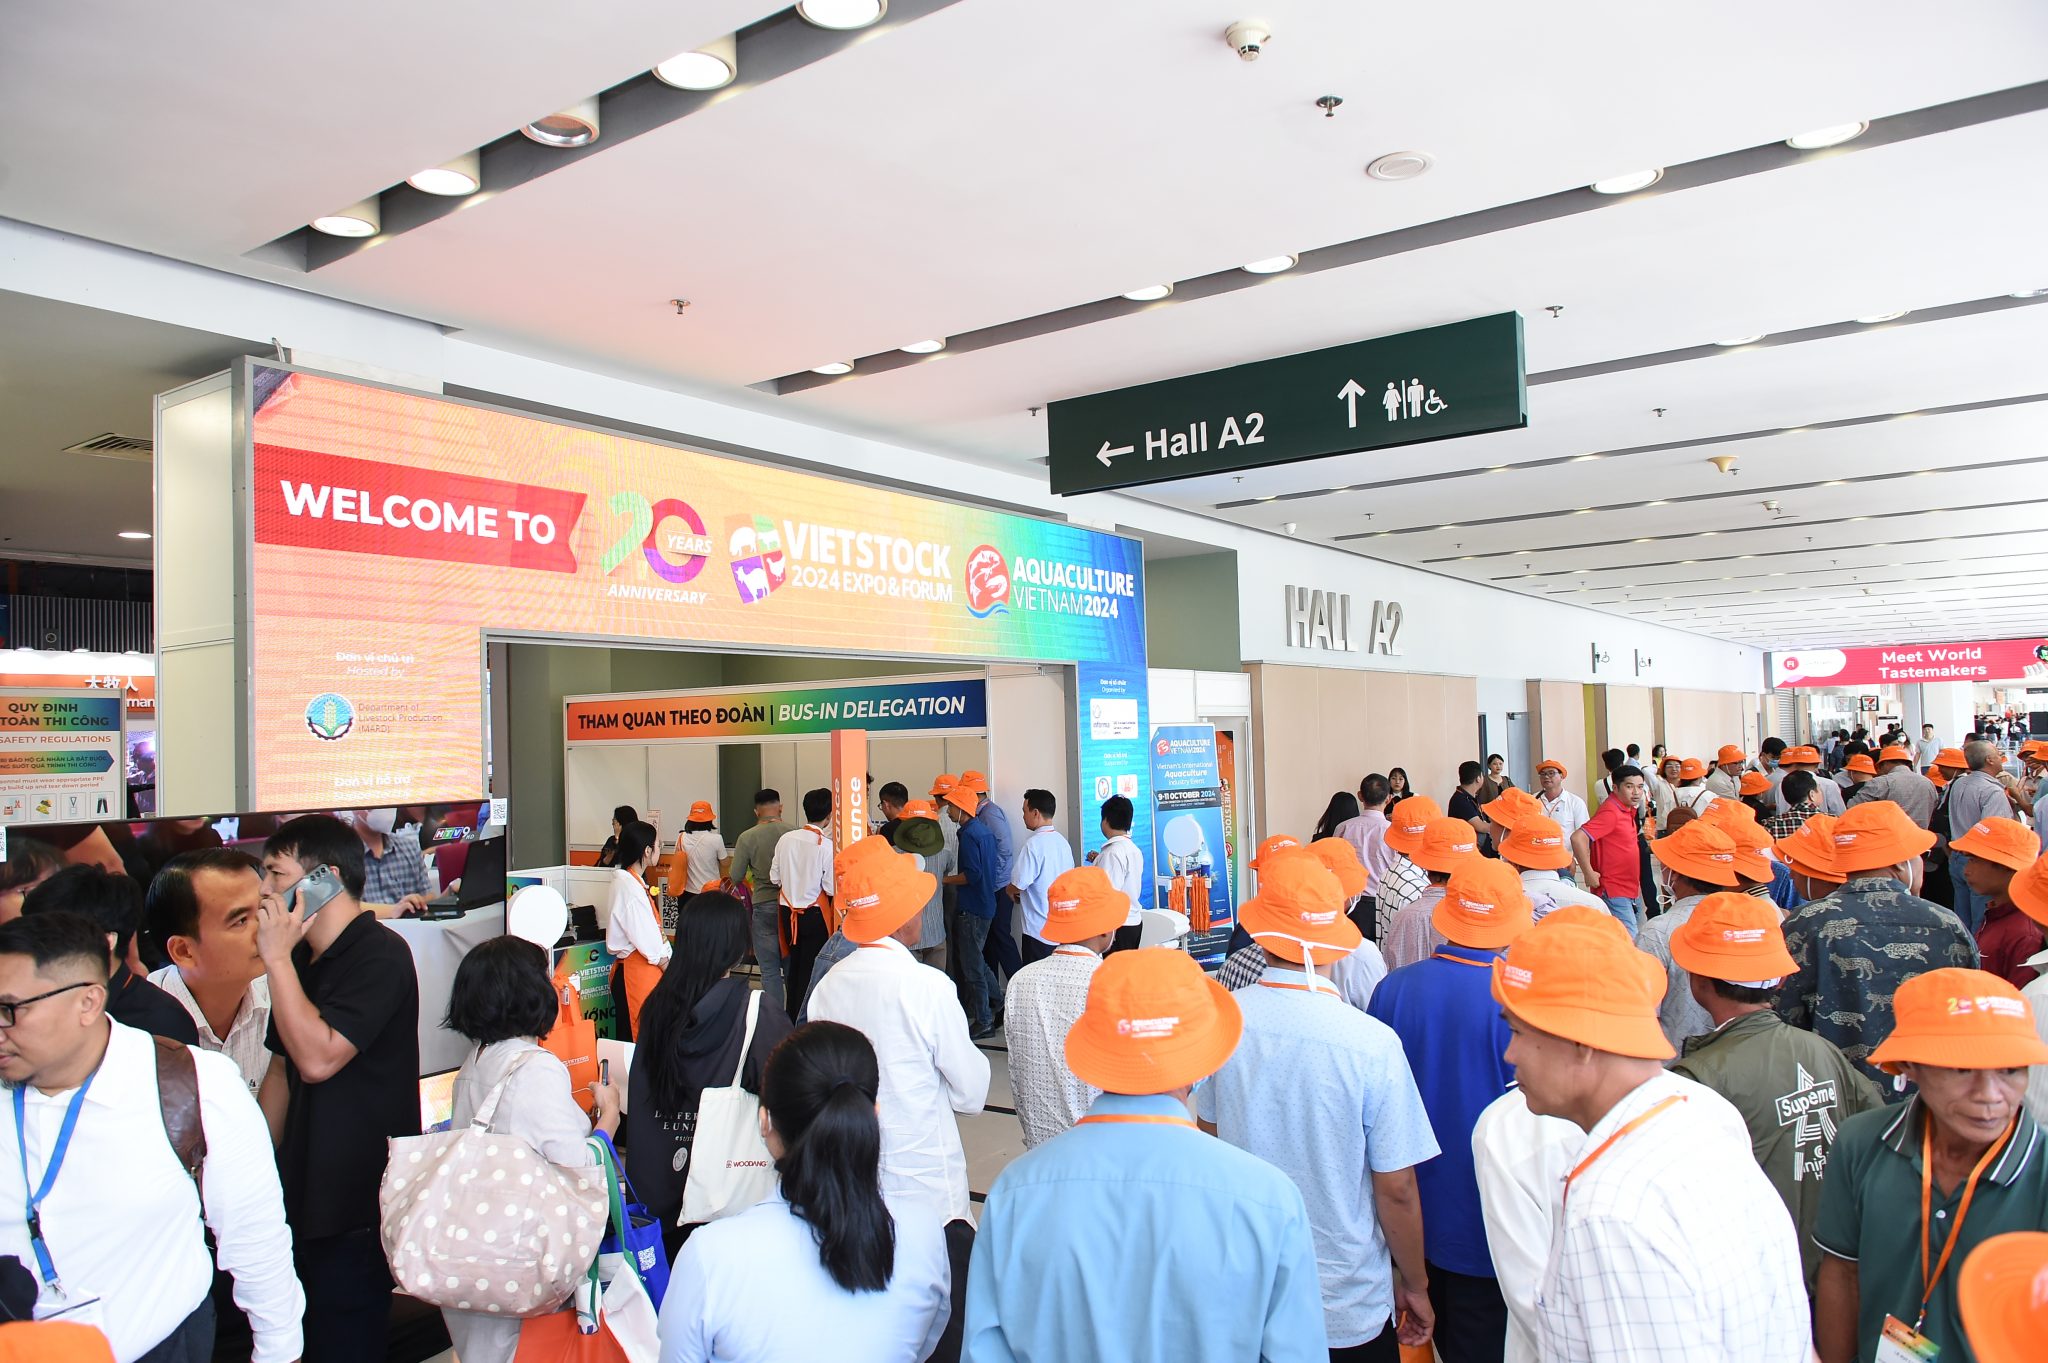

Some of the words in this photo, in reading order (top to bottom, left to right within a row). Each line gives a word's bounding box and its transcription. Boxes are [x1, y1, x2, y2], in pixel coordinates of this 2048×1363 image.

[1145, 421, 1208, 461] Hall
[1218, 412, 1265, 450] A2
[280, 480, 498, 539] WELCOME
[507, 510, 556, 545] TO
[667, 534, 712, 553] YEARS
[783, 520, 951, 579] VIETSTOCK
[792, 564, 841, 592] 2024
[1012, 556, 1134, 598] AQUACULTURE
[607, 583, 708, 604] ANNIVERSARY
[1285, 584, 1358, 653] HALL
[1369, 600, 1405, 656] A2
[1882, 651, 1923, 664] Meet
[1927, 647, 1982, 661] World
[1878, 663, 1988, 680] Tastemakers
[8, 702, 39, 713] QUY
[42, 702, 78, 715] ĐỊNH
[44, 716, 67, 726] THI
[70, 714, 110, 726] CÔNG
[578, 712, 619, 730] THAM
[622, 709, 667, 730] QUAN
[669, 707, 712, 726] THEO
[715, 702, 765, 724] ĐOÀN
[778, 699, 838, 723] BUS-IN
[842, 695, 967, 720] DELEGATION
[0, 736, 37, 744] SAFETY
[40, 735, 112, 743] REGULATIONS
[1164, 769, 1208, 779] Aquaculture
[1170, 791, 1200, 800] OCTOBER
[850, 776, 863, 844] ance
[1224, 790, 1233, 837] VIETSTOCK
[1781, 1087, 1836, 1117] Supeme
[733, 1160, 767, 1168] WOODANG
